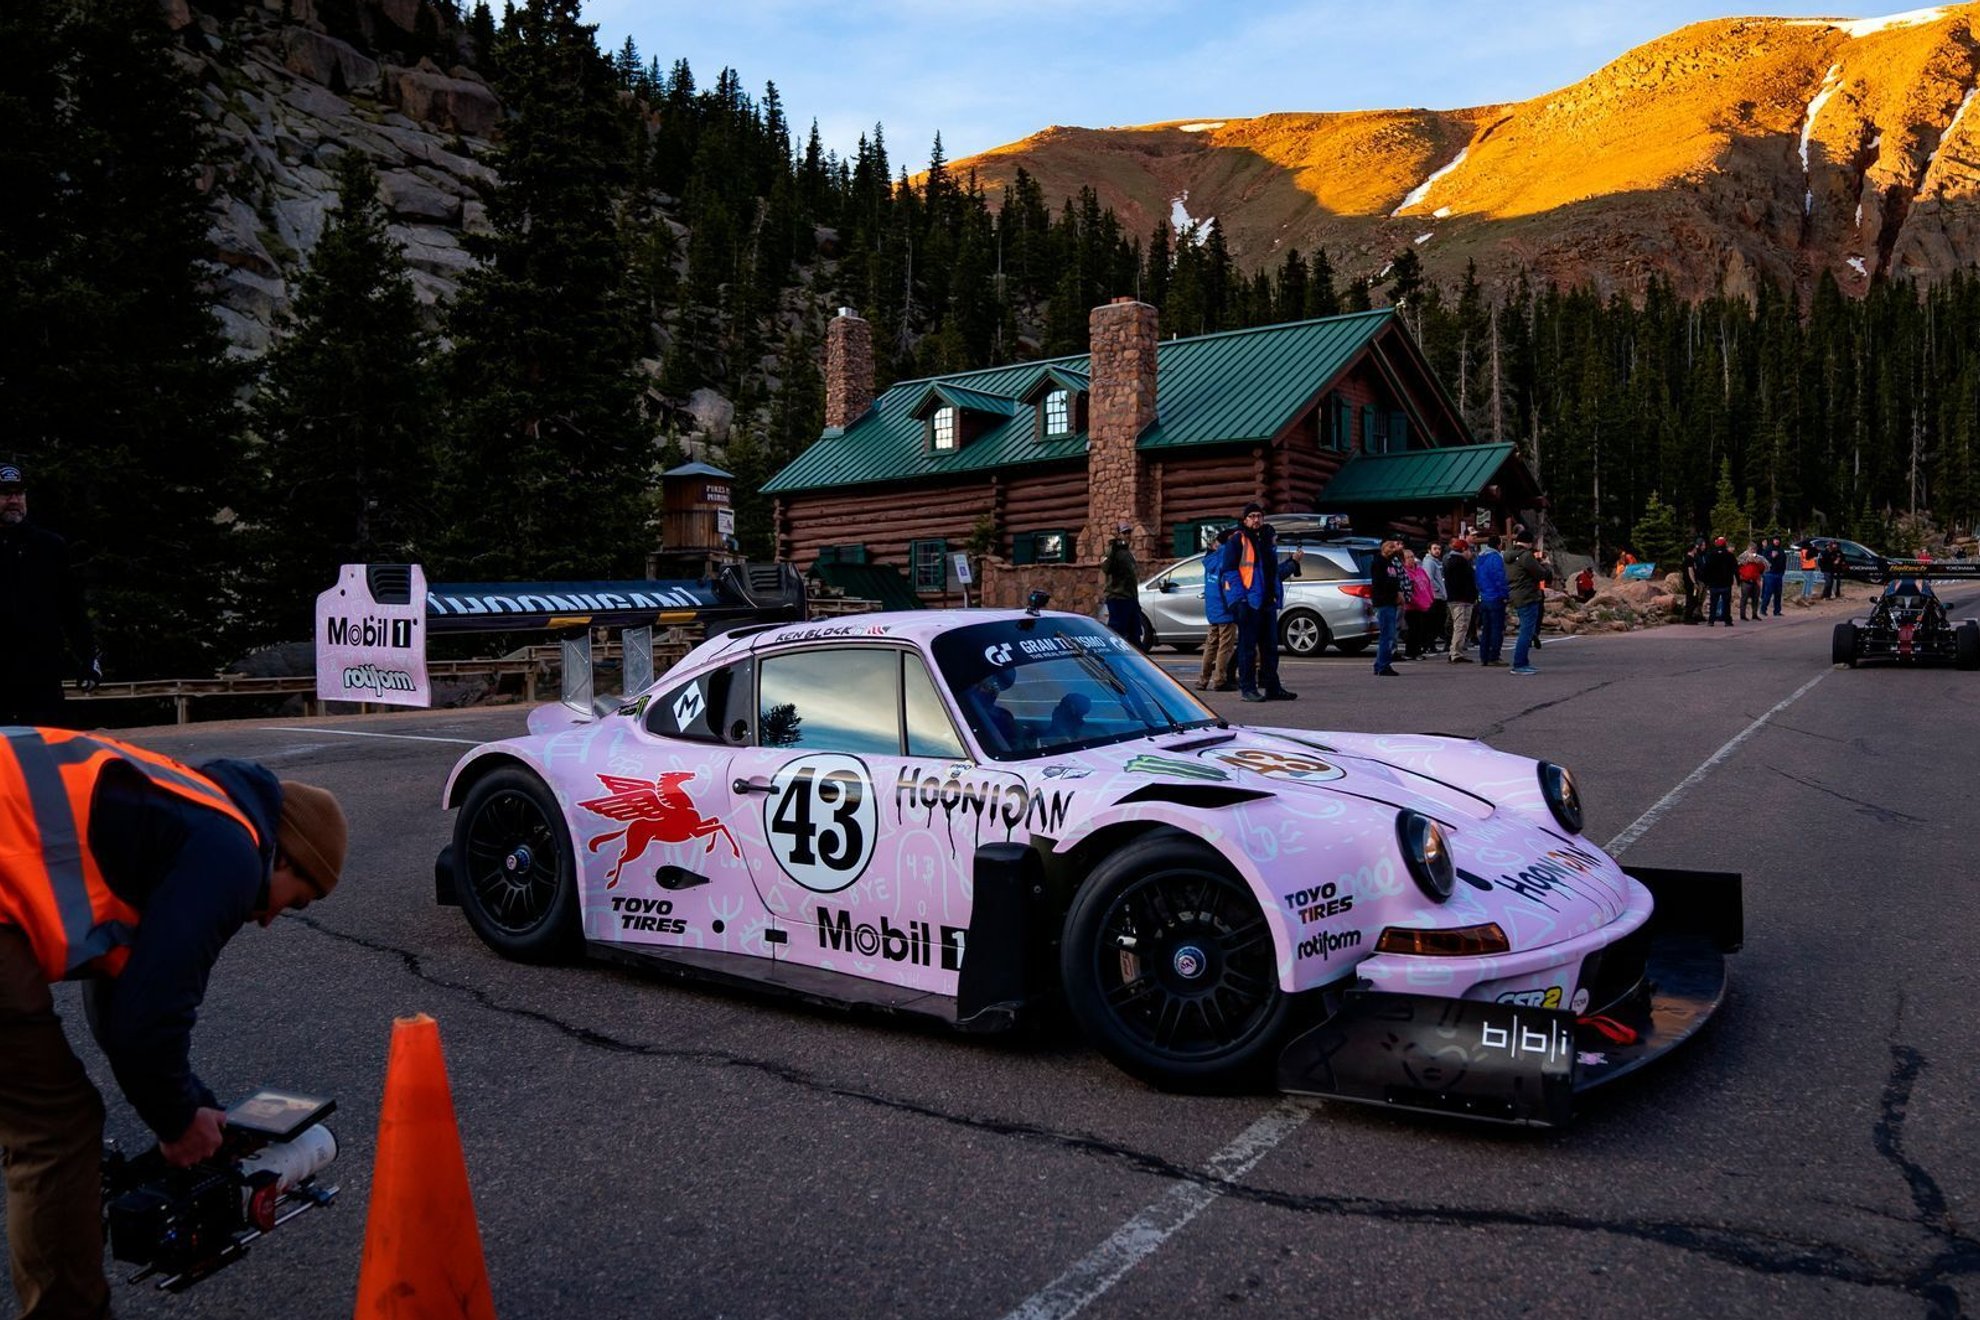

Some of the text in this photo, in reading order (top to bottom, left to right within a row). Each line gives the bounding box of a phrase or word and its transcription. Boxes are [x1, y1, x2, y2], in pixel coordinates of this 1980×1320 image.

[327, 615, 388, 647] Mobil
[775, 626, 853, 642] KEN BLOCK
[1019, 637, 1058, 654] GRAN
[1053, 635, 1105, 651] TUISMO
[343, 664, 416, 697] rotiform
[677, 694, 700, 718] M
[895, 765, 1076, 843] HOONIGAN
[772, 767, 863, 871] 43
[611, 897, 674, 916] TOYO
[1284, 882, 1337, 909] TOYO
[1297, 895, 1353, 924] TIRES
[620, 914, 688, 935] TIRES
[816, 906, 931, 967] Mobil
[1297, 930, 1362, 961] rotiform
